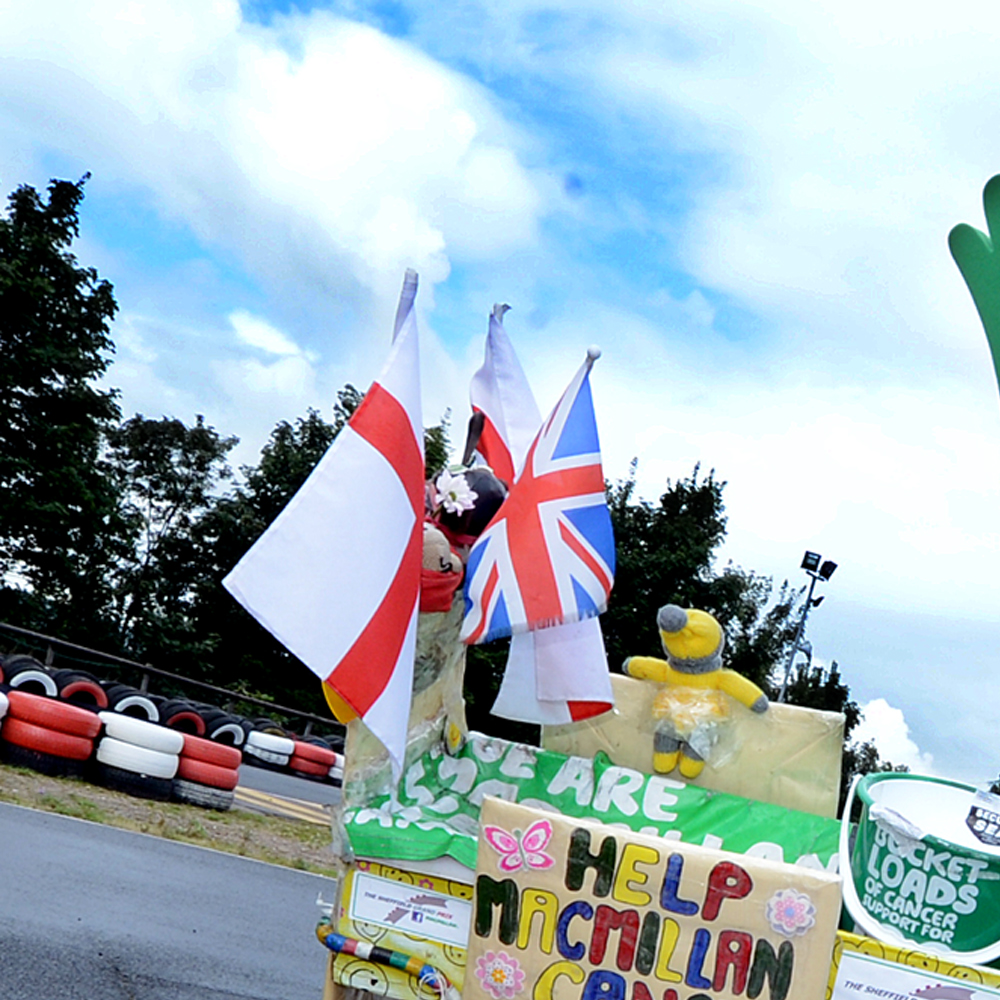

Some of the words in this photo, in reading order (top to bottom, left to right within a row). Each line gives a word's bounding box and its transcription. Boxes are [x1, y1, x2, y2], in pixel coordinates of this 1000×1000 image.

[547, 756, 686, 822] ARE
[564, 827, 752, 921] HELP
[865, 876, 884, 897] OF
[884, 890, 959, 930] CANCER
[868, 843, 979, 915] LOADS
[921, 923, 955, 945] FOR
[844, 980, 863, 991] THE
